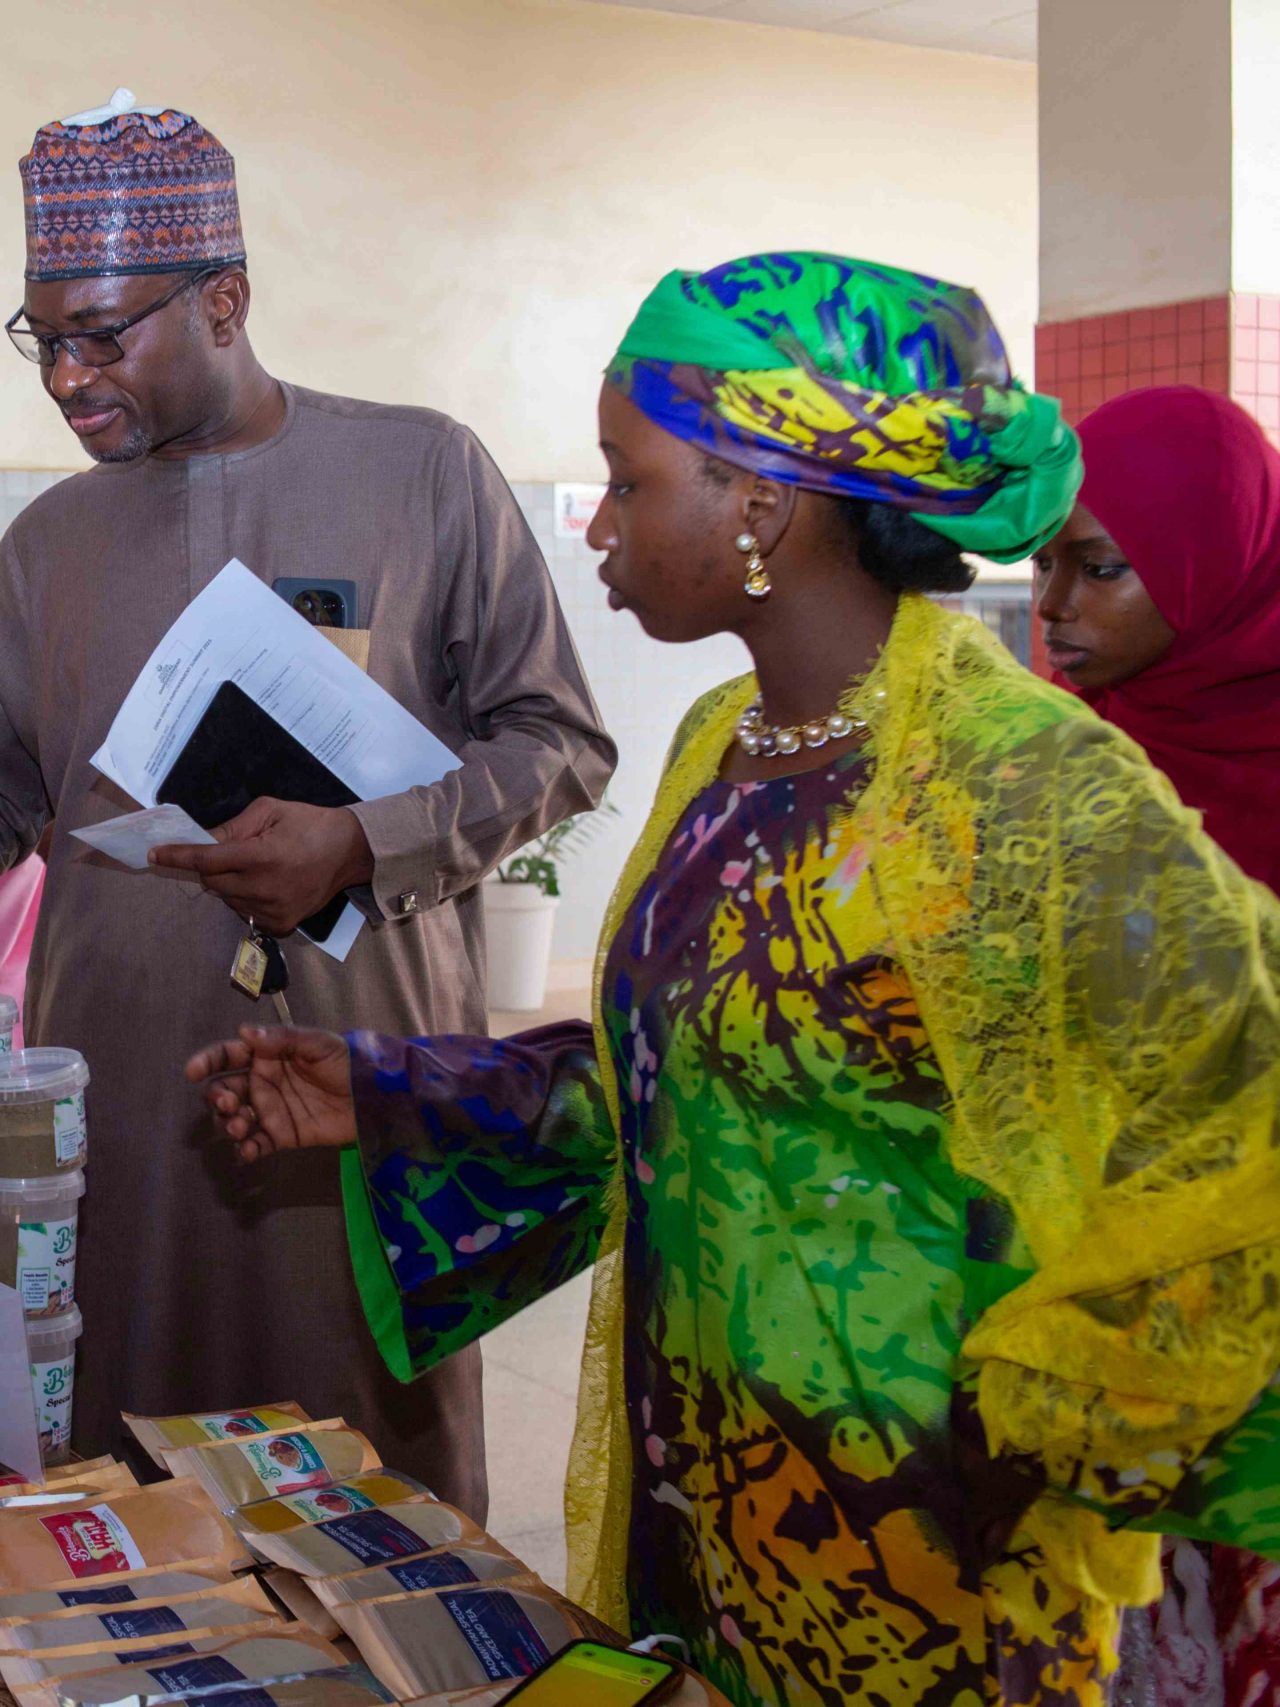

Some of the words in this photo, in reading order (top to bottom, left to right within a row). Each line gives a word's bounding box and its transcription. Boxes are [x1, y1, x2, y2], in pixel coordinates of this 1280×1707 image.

[449, 1599, 470, 1628] SPECIAL
[464, 1606, 479, 1624] TEA
[474, 1621, 489, 1640] AND
[465, 1626, 501, 1678] BADAWIYYAH
[484, 1637, 503, 1661] SPICE
